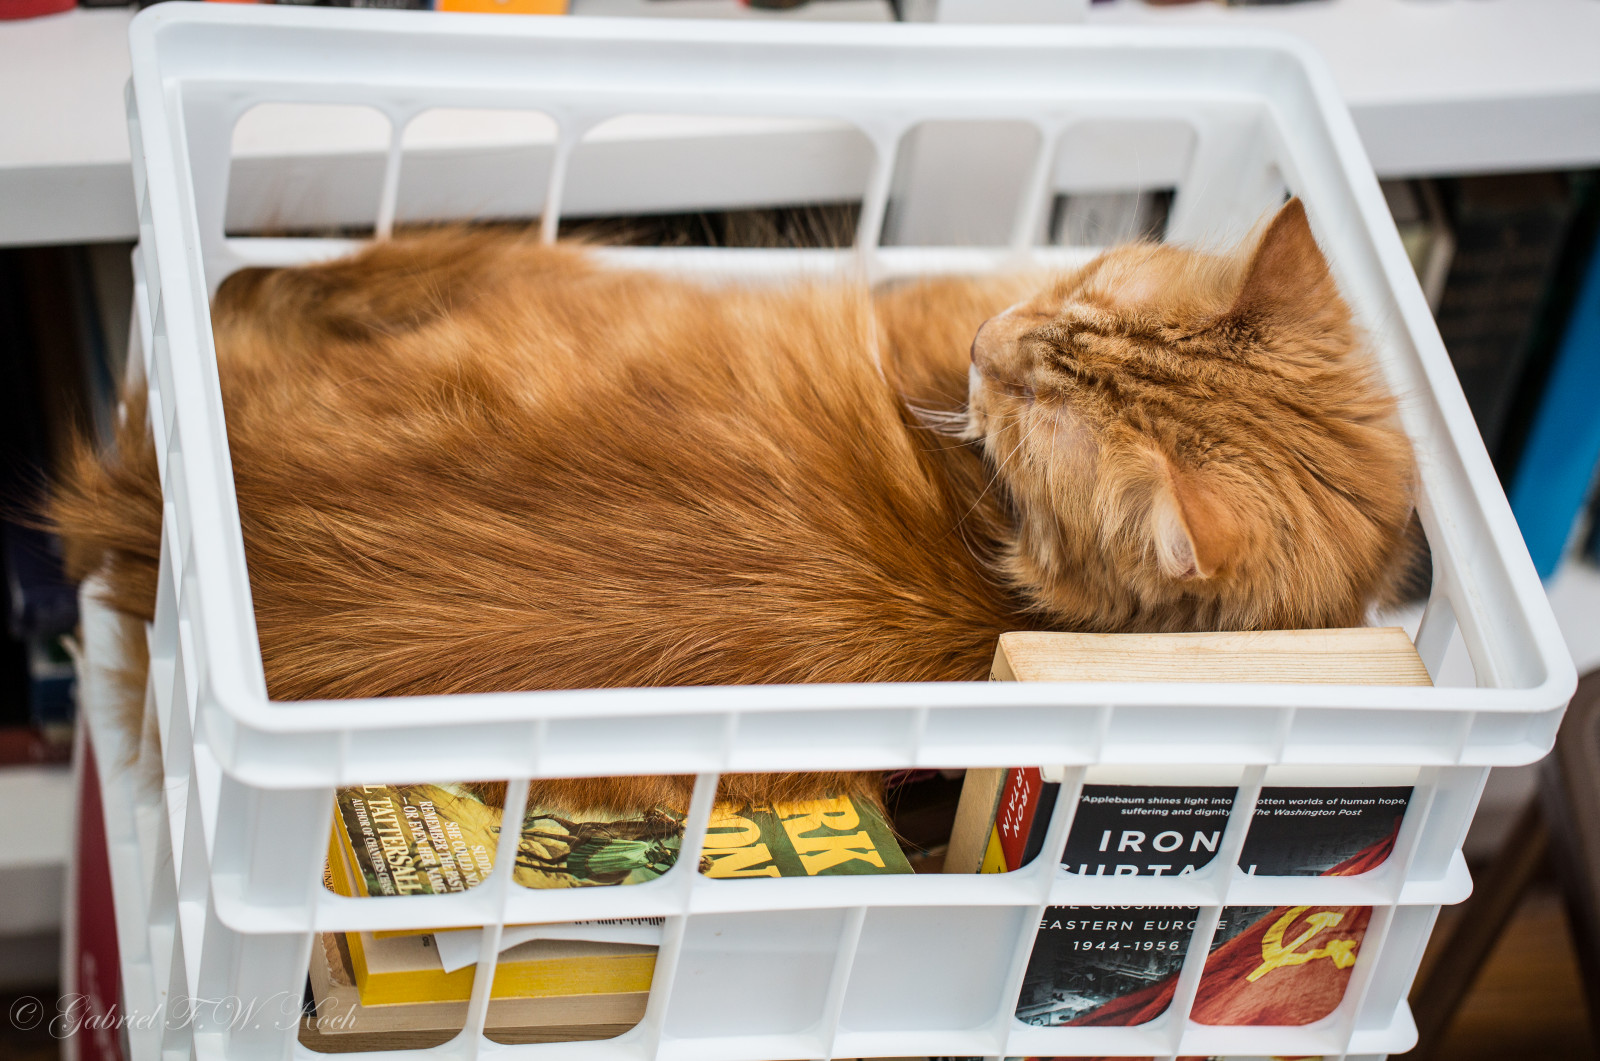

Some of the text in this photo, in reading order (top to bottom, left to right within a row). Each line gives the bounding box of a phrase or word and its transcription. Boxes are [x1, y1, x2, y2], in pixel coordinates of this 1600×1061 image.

[1003, 766, 1025, 838] RTAIN
[1013, 780, 1030, 839] IRON
[1120, 807, 1169, 817] suffering
[1171, 808, 1193, 816] and
[1274, 808, 1336, 817] Washington
[1338, 808, 1363, 816] Post
[1147, 796, 1182, 805] shines
[1184, 797, 1209, 806] light
[1211, 797, 1233, 805] into
[1256, 797, 1286, 805] otten
[1288, 797, 1324, 805] worlds
[1326, 797, 1339, 805] of
[1340, 797, 1376, 805] human
[1378, 797, 1407, 806] hope,
[351, 798, 370, 830] AUTHOR
[361, 827, 375, 838] OF
[444, 821, 463, 840] SHE
[367, 796, 423, 895] TATTERSALL
[408, 821, 428, 845] EVEN
[419, 800, 466, 893] REMEMBER THE PAST
[771, 794, 886, 876] RK
[1098, 829, 1221, 853] IRON
[417, 846, 437, 867] HER
[452, 840, 475, 872] COULD
[1038, 919, 1228, 931] EASTERN EUROE
